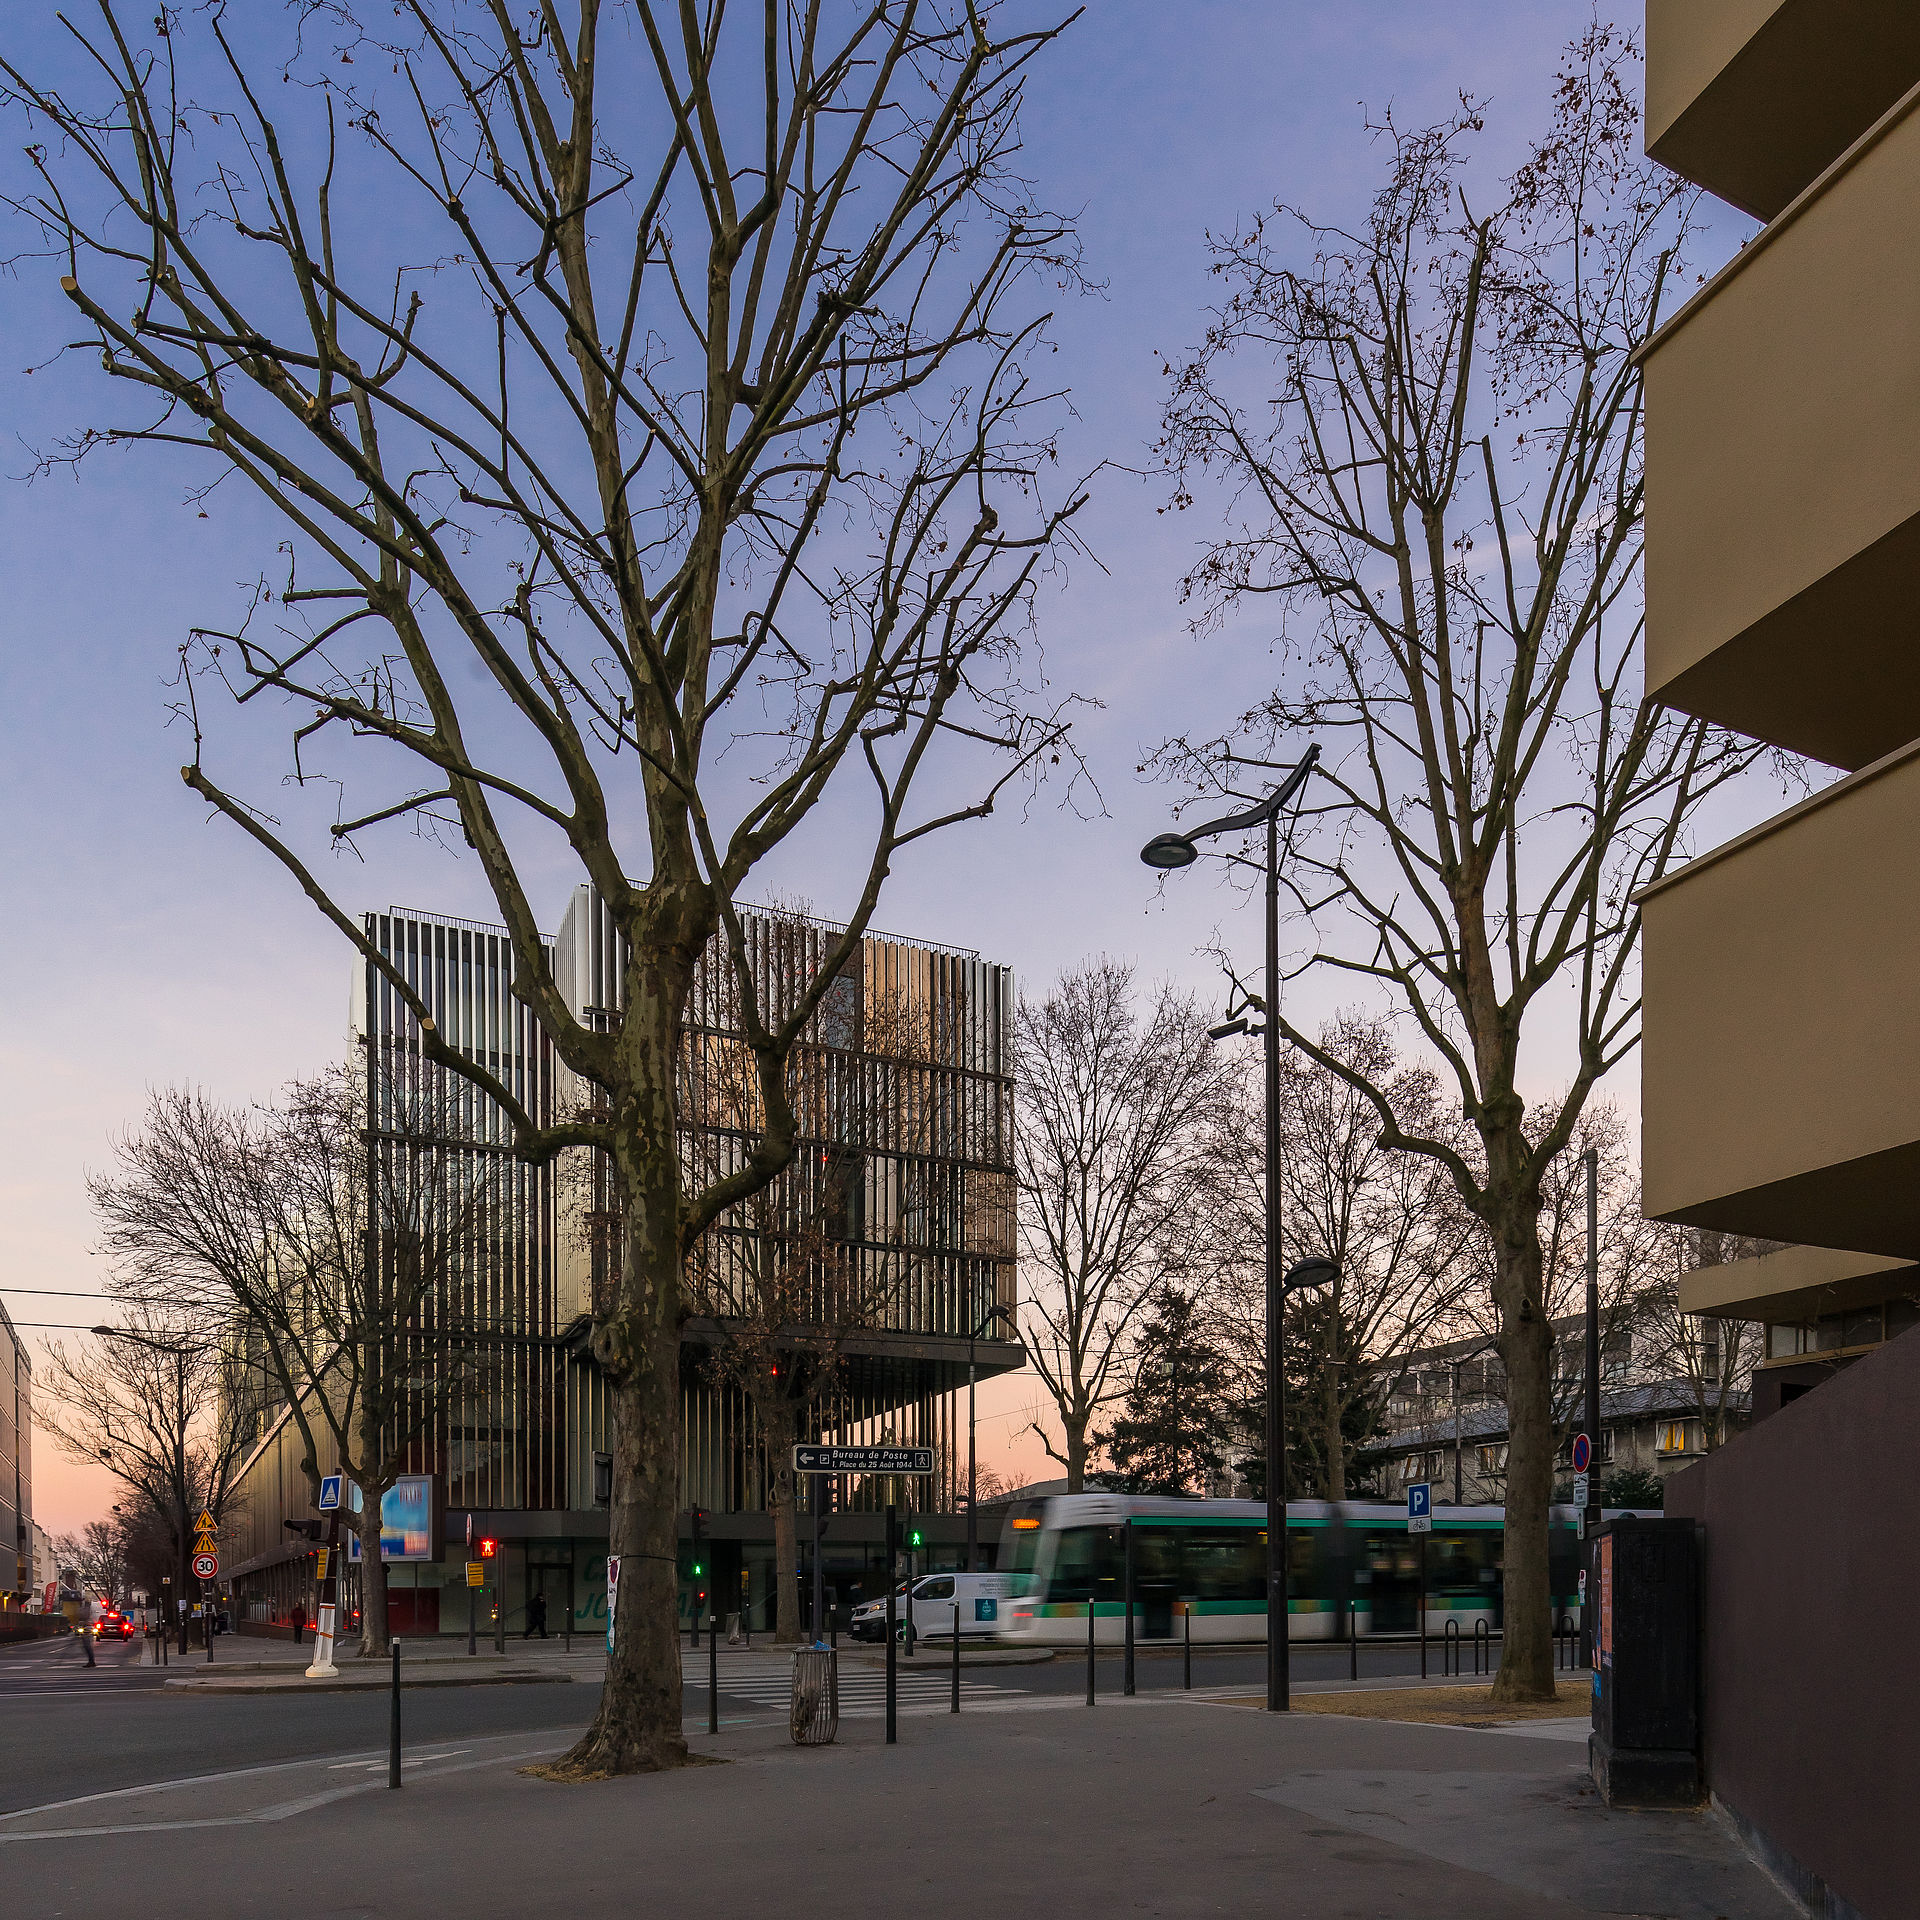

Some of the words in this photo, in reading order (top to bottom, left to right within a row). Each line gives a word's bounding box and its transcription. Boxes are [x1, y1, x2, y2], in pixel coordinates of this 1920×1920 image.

[832, 1449, 864, 1459] Bureau
[868, 1450, 879, 1459] de
[882, 1450, 908, 1460] Poste
[839, 1460, 857, 1468] Place
[896, 1461, 912, 1469] 1944
[1414, 1491, 1424, 1512] P
[197, 1560, 213, 1572] 30
